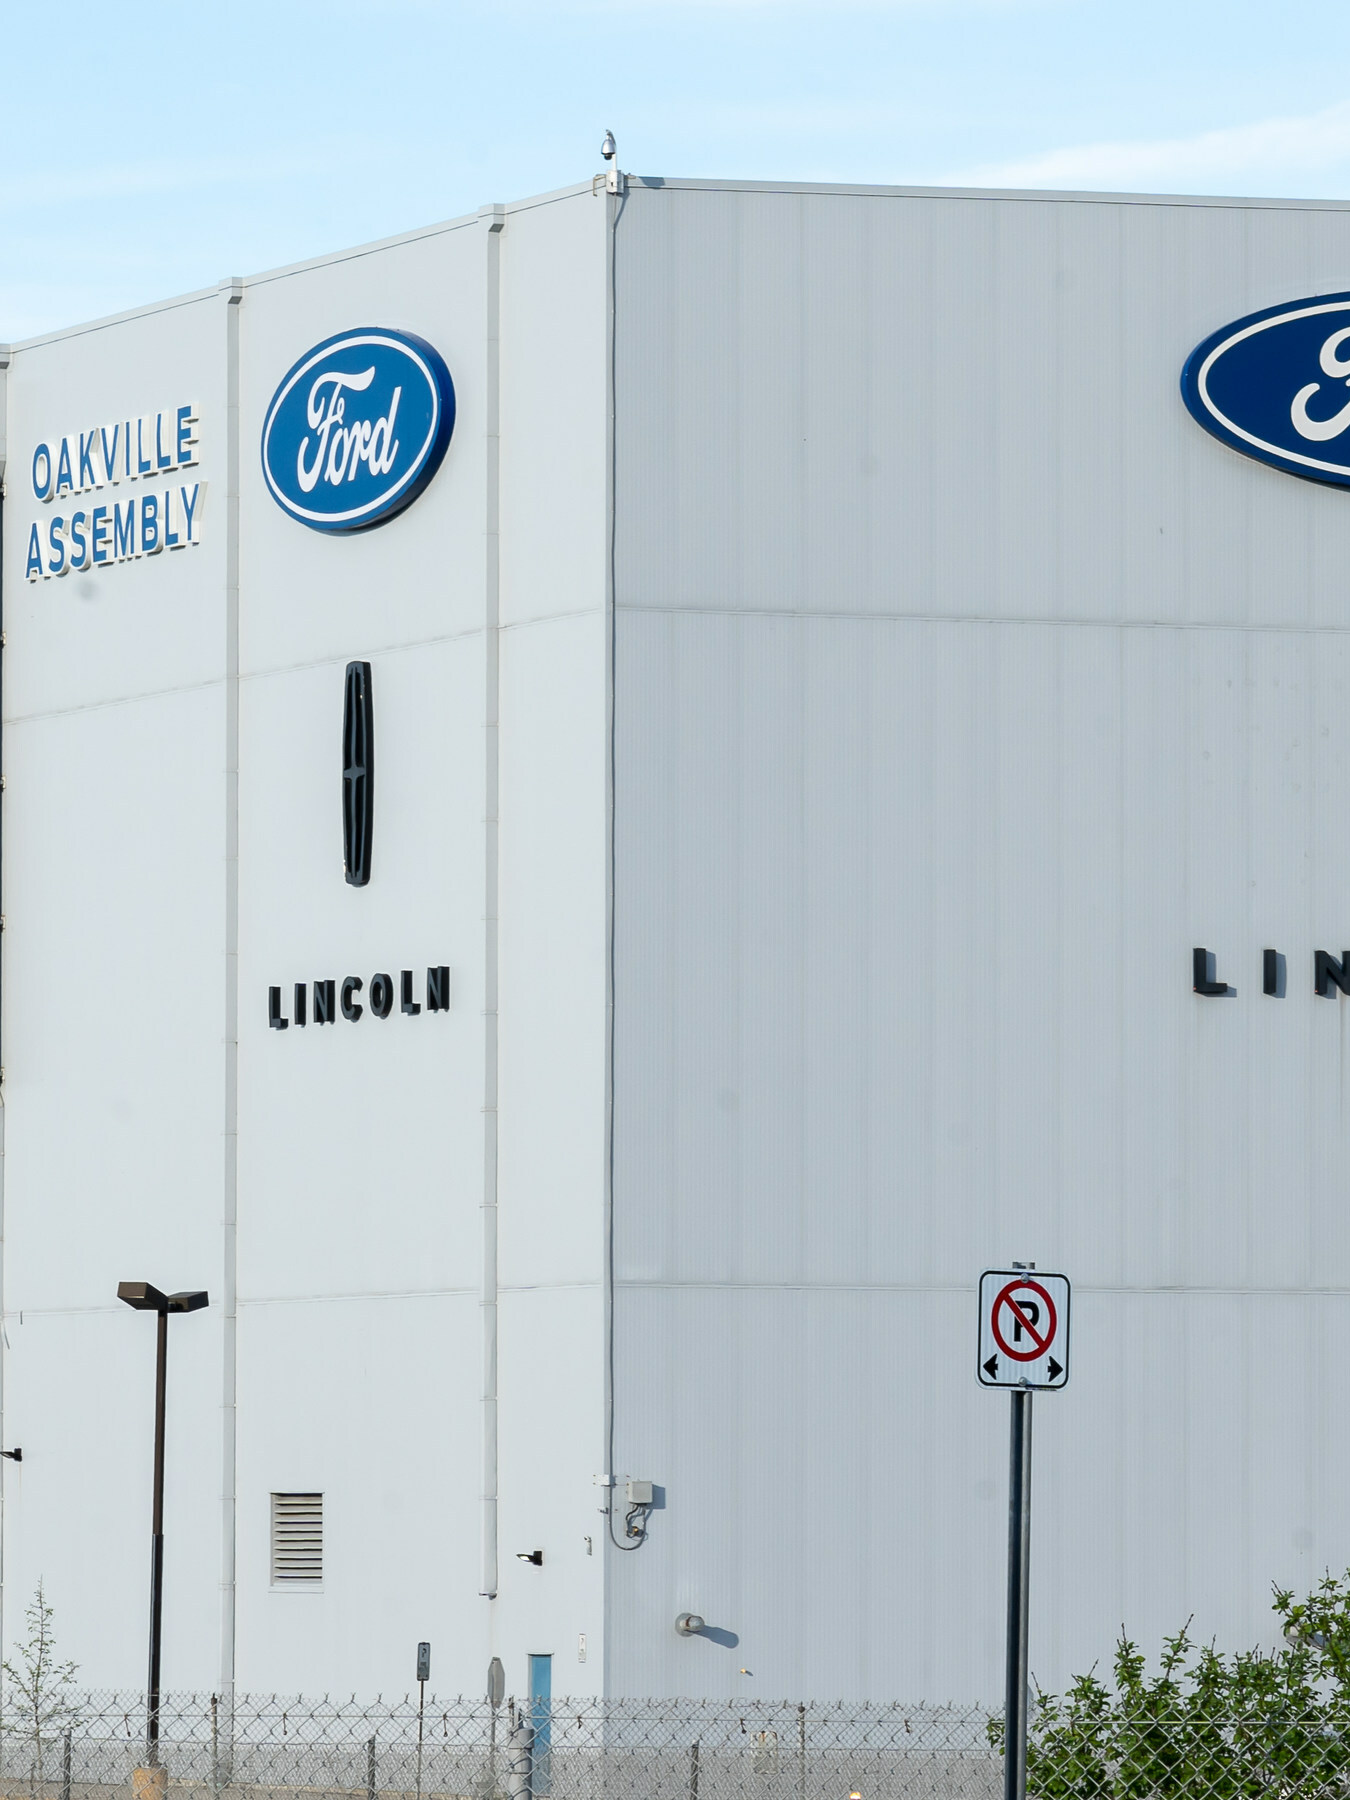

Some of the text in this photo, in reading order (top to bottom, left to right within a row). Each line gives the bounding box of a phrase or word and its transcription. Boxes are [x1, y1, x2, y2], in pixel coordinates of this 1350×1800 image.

[32, 404, 197, 501] OAKVILLE
[297, 366, 402, 492] Ford
[25, 482, 203, 579] ASSEMBLY
[268, 966, 450, 1030] LINCOLN
[1013, 1300, 1040, 1342] P
